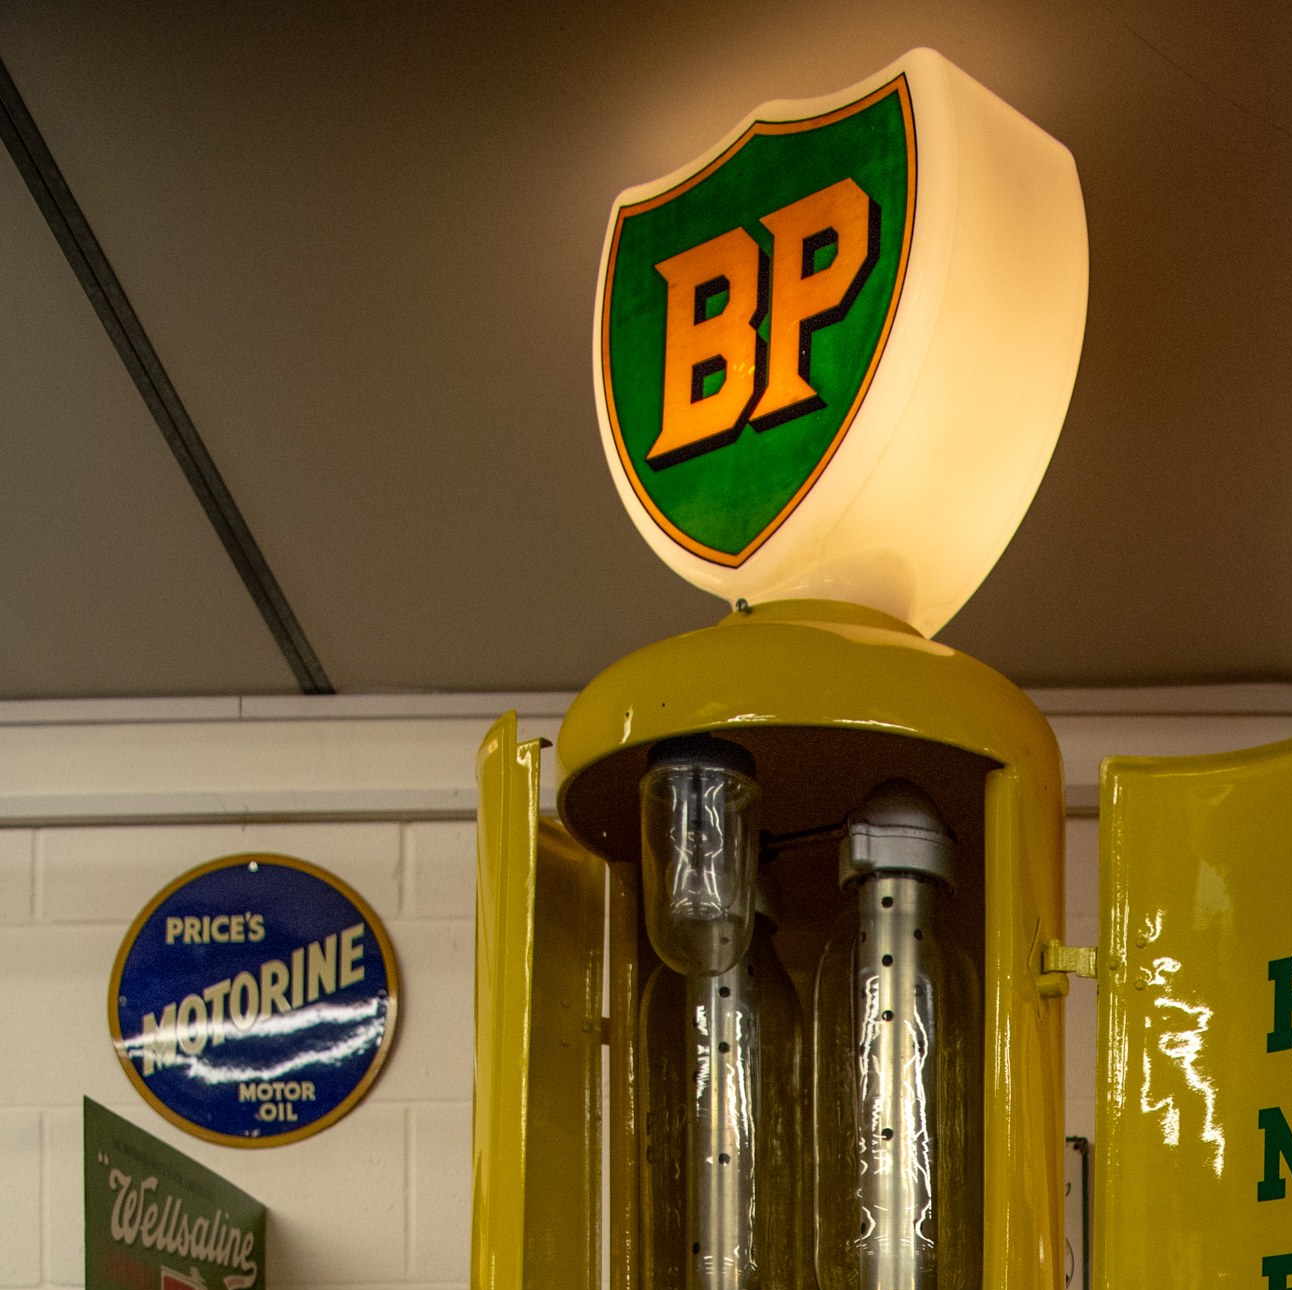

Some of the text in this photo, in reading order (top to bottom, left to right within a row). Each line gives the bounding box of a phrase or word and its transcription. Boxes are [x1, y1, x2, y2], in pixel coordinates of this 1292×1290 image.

[645, 177, 882, 472] BP
[165, 911, 266, 945] PRICE'S
[142, 922, 366, 1078] MOTORINE
[239, 1081, 316, 1102] MOTOR
[259, 1102, 298, 1122] OIL
